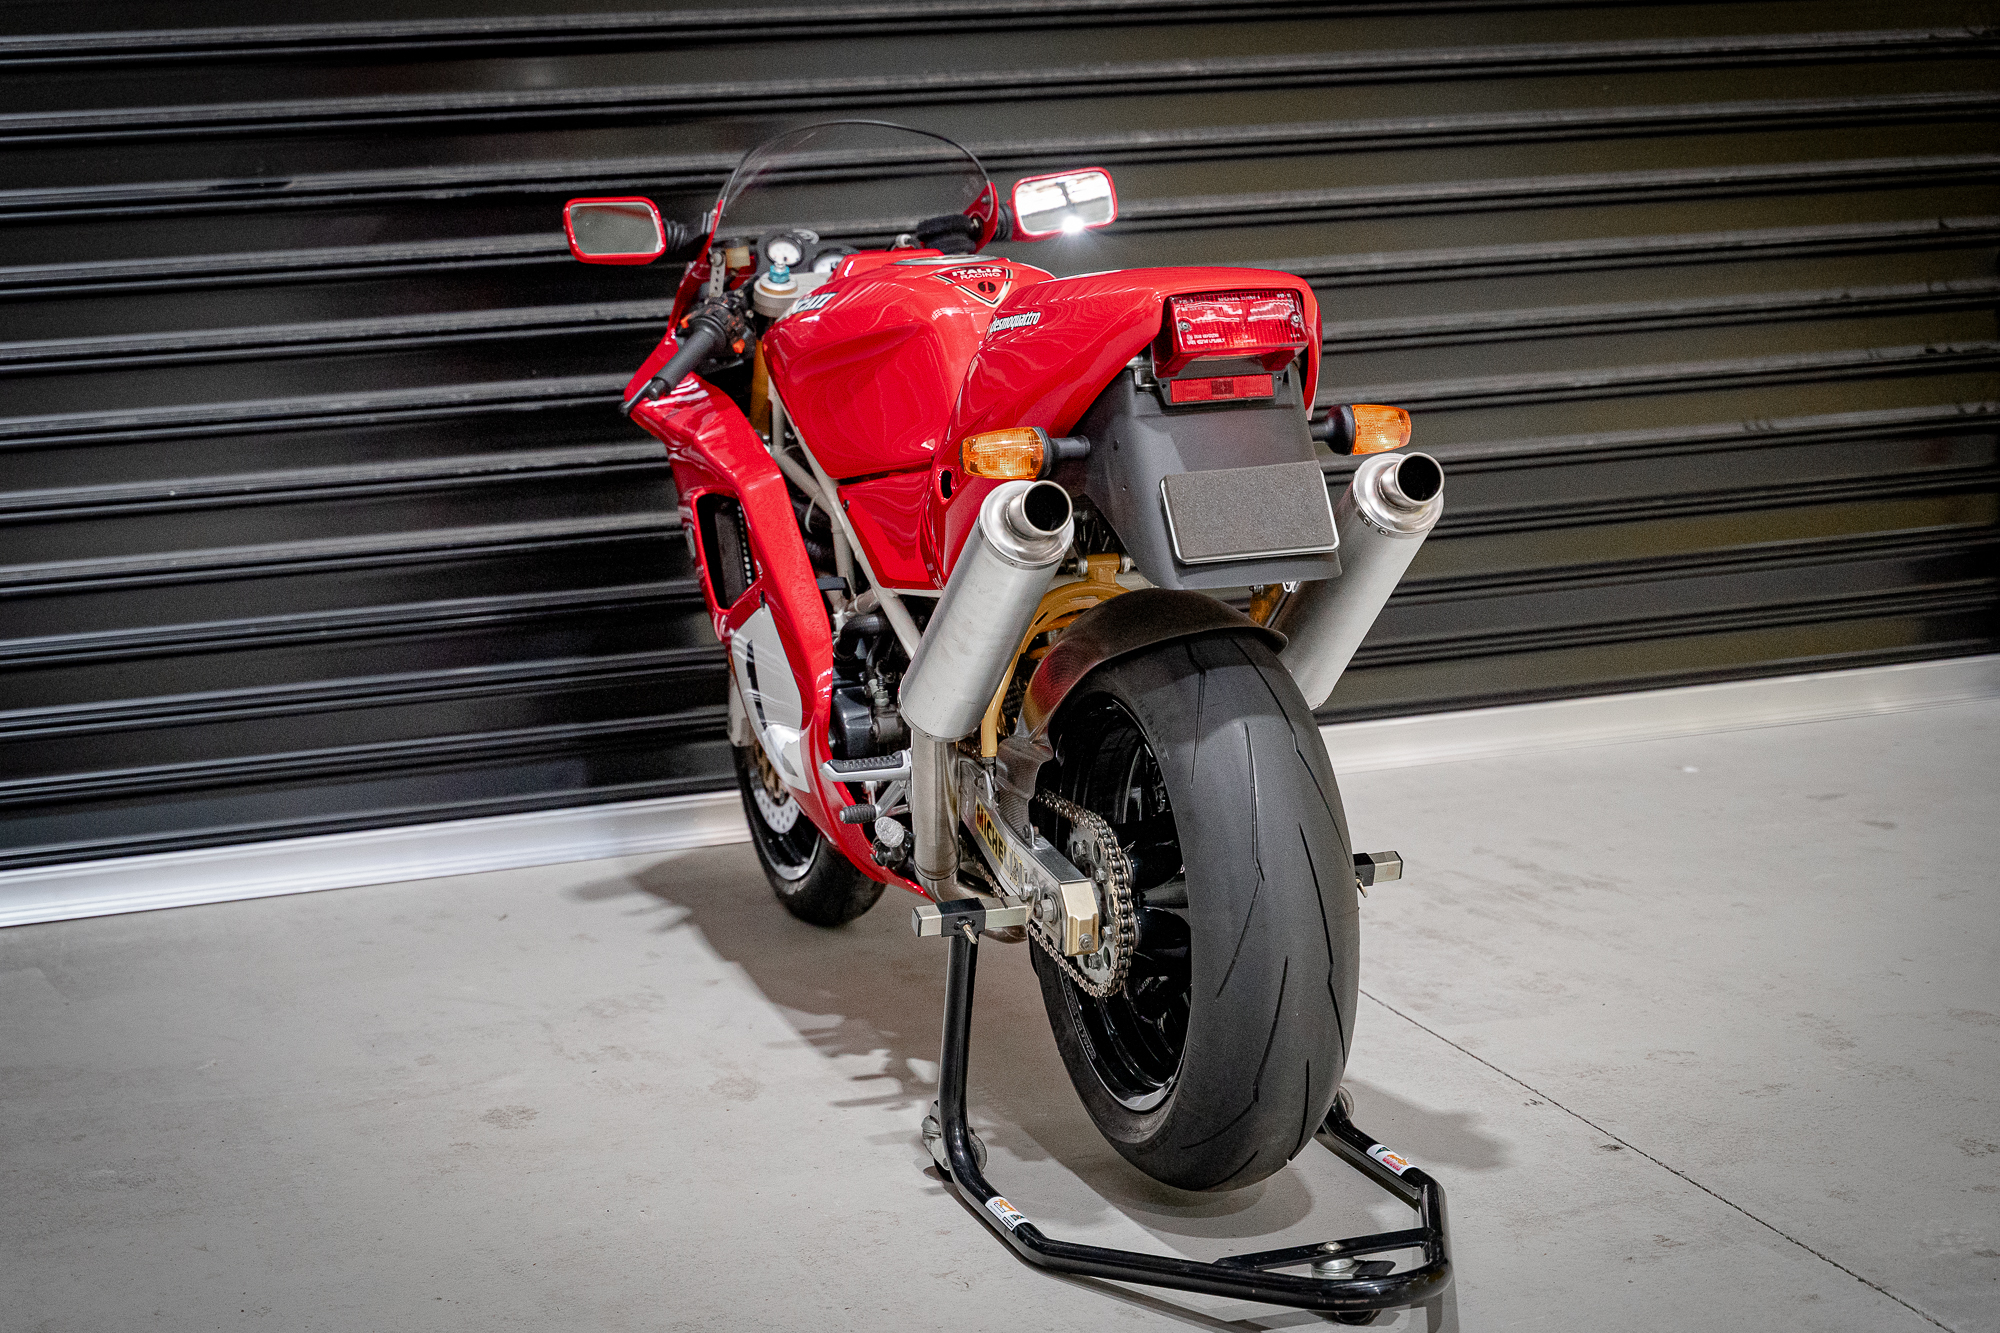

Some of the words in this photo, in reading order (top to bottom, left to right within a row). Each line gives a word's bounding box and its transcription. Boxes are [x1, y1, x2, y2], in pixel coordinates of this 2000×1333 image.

[952, 268, 1003, 277] ITALIA
[960, 272, 1001, 280] RACING
[982, 281, 991, 293] 1
